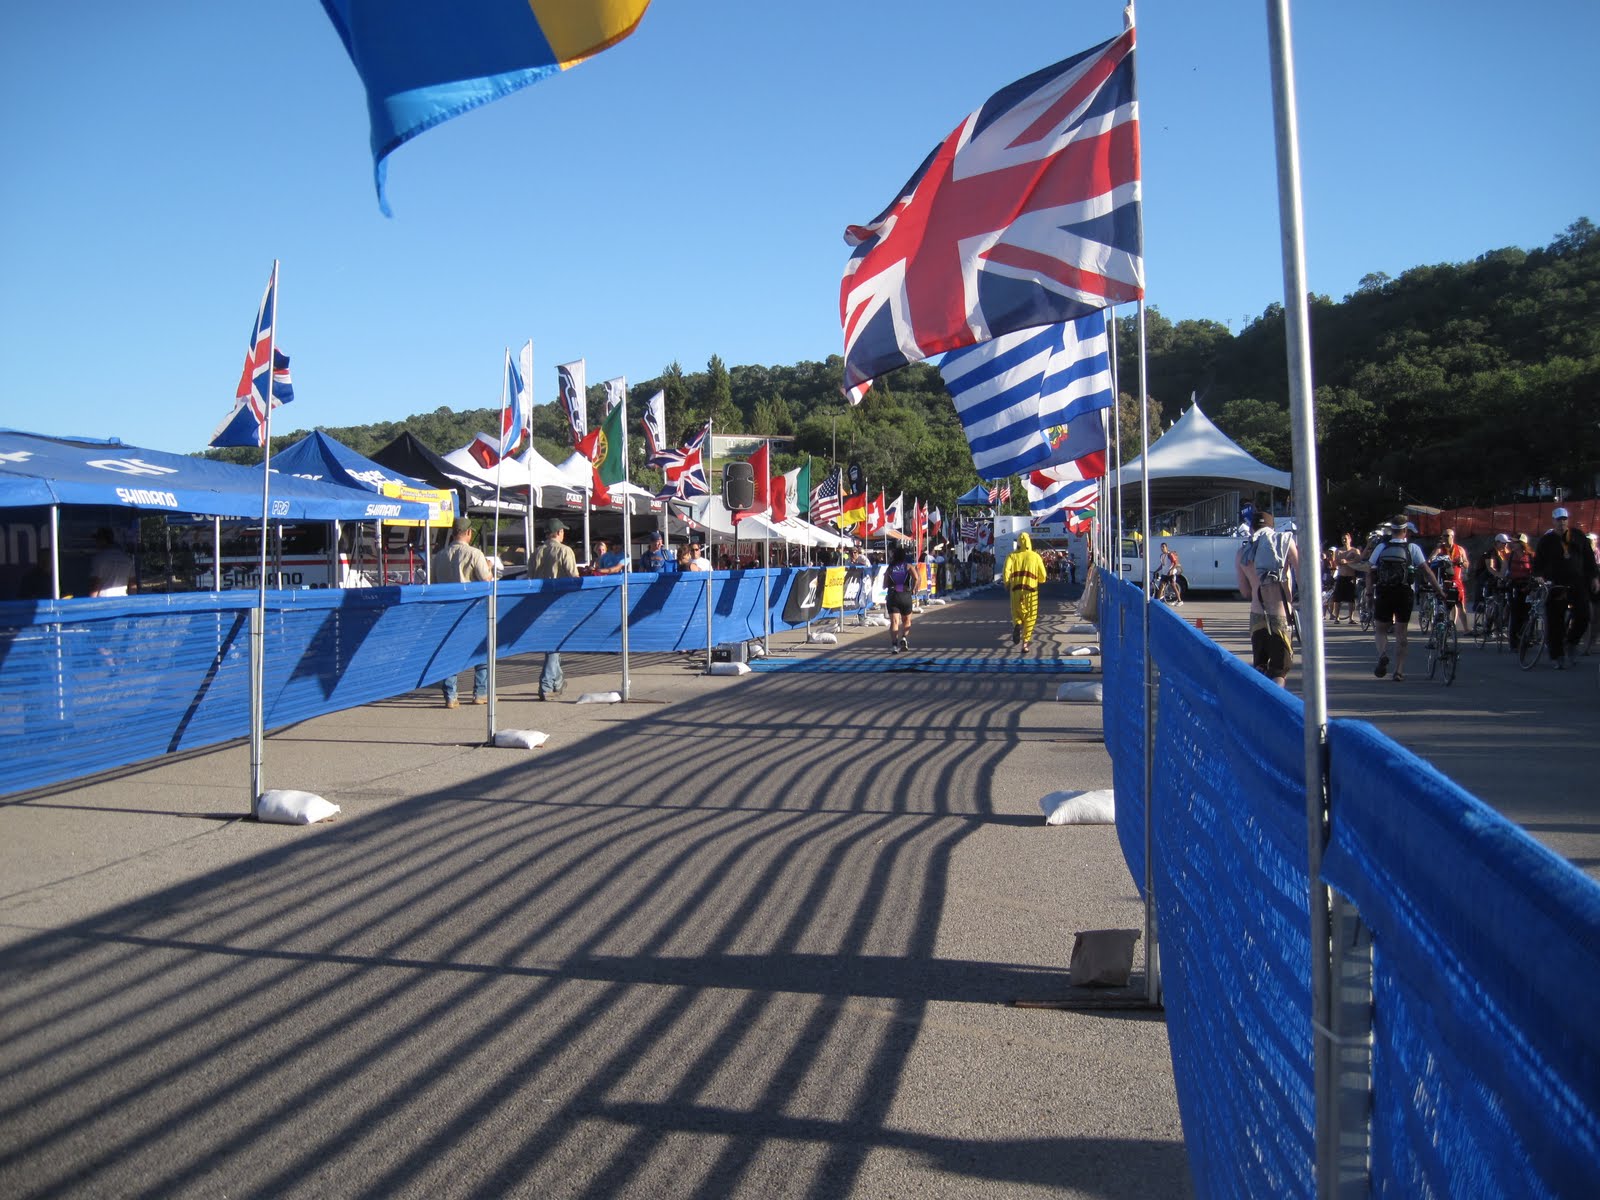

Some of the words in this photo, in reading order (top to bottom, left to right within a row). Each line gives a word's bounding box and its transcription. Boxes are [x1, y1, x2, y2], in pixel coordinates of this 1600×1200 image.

[115, 487, 178, 508] SHIMANO
[271, 500, 290, 516] PRO
[364, 503, 402, 517] SHIMANO
